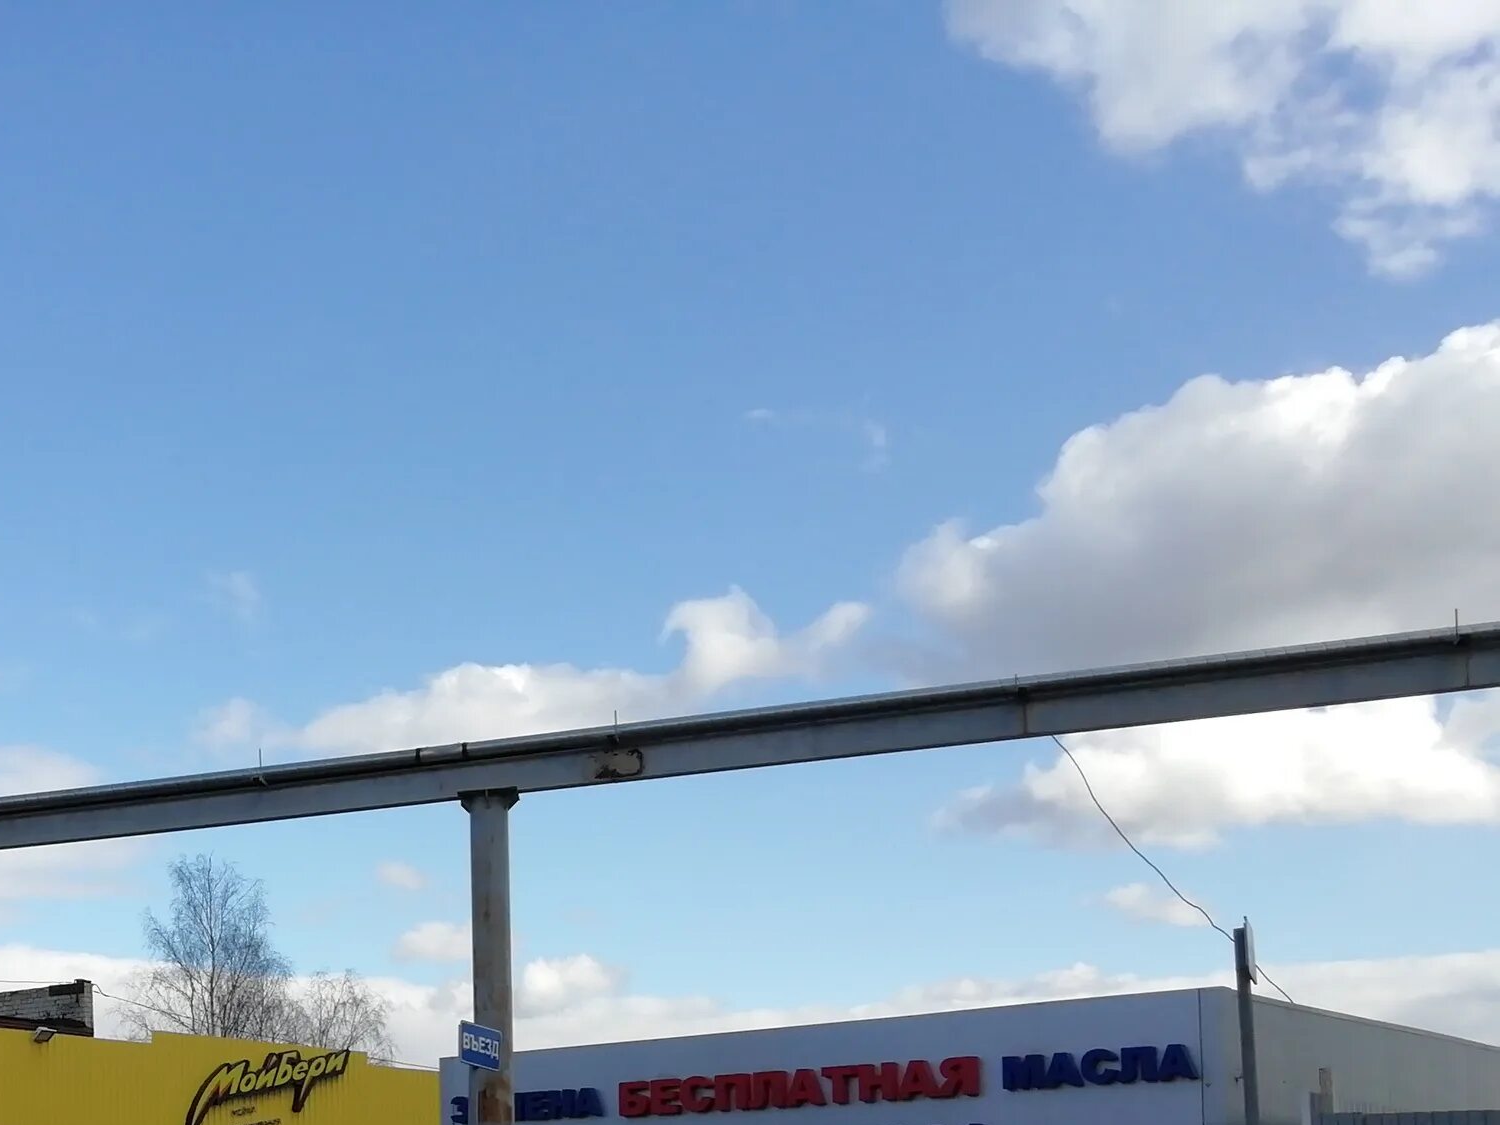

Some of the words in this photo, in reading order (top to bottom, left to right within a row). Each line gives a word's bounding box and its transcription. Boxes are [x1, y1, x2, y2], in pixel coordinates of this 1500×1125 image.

[462, 1031, 500, 1061] ВЪЕЗД
[451, 1088, 604, 1125] ЗЕНА
[618, 1056, 981, 1118] БЕСПЛАТНАЯ
[1002, 1044, 1199, 1091] МАСЛА
